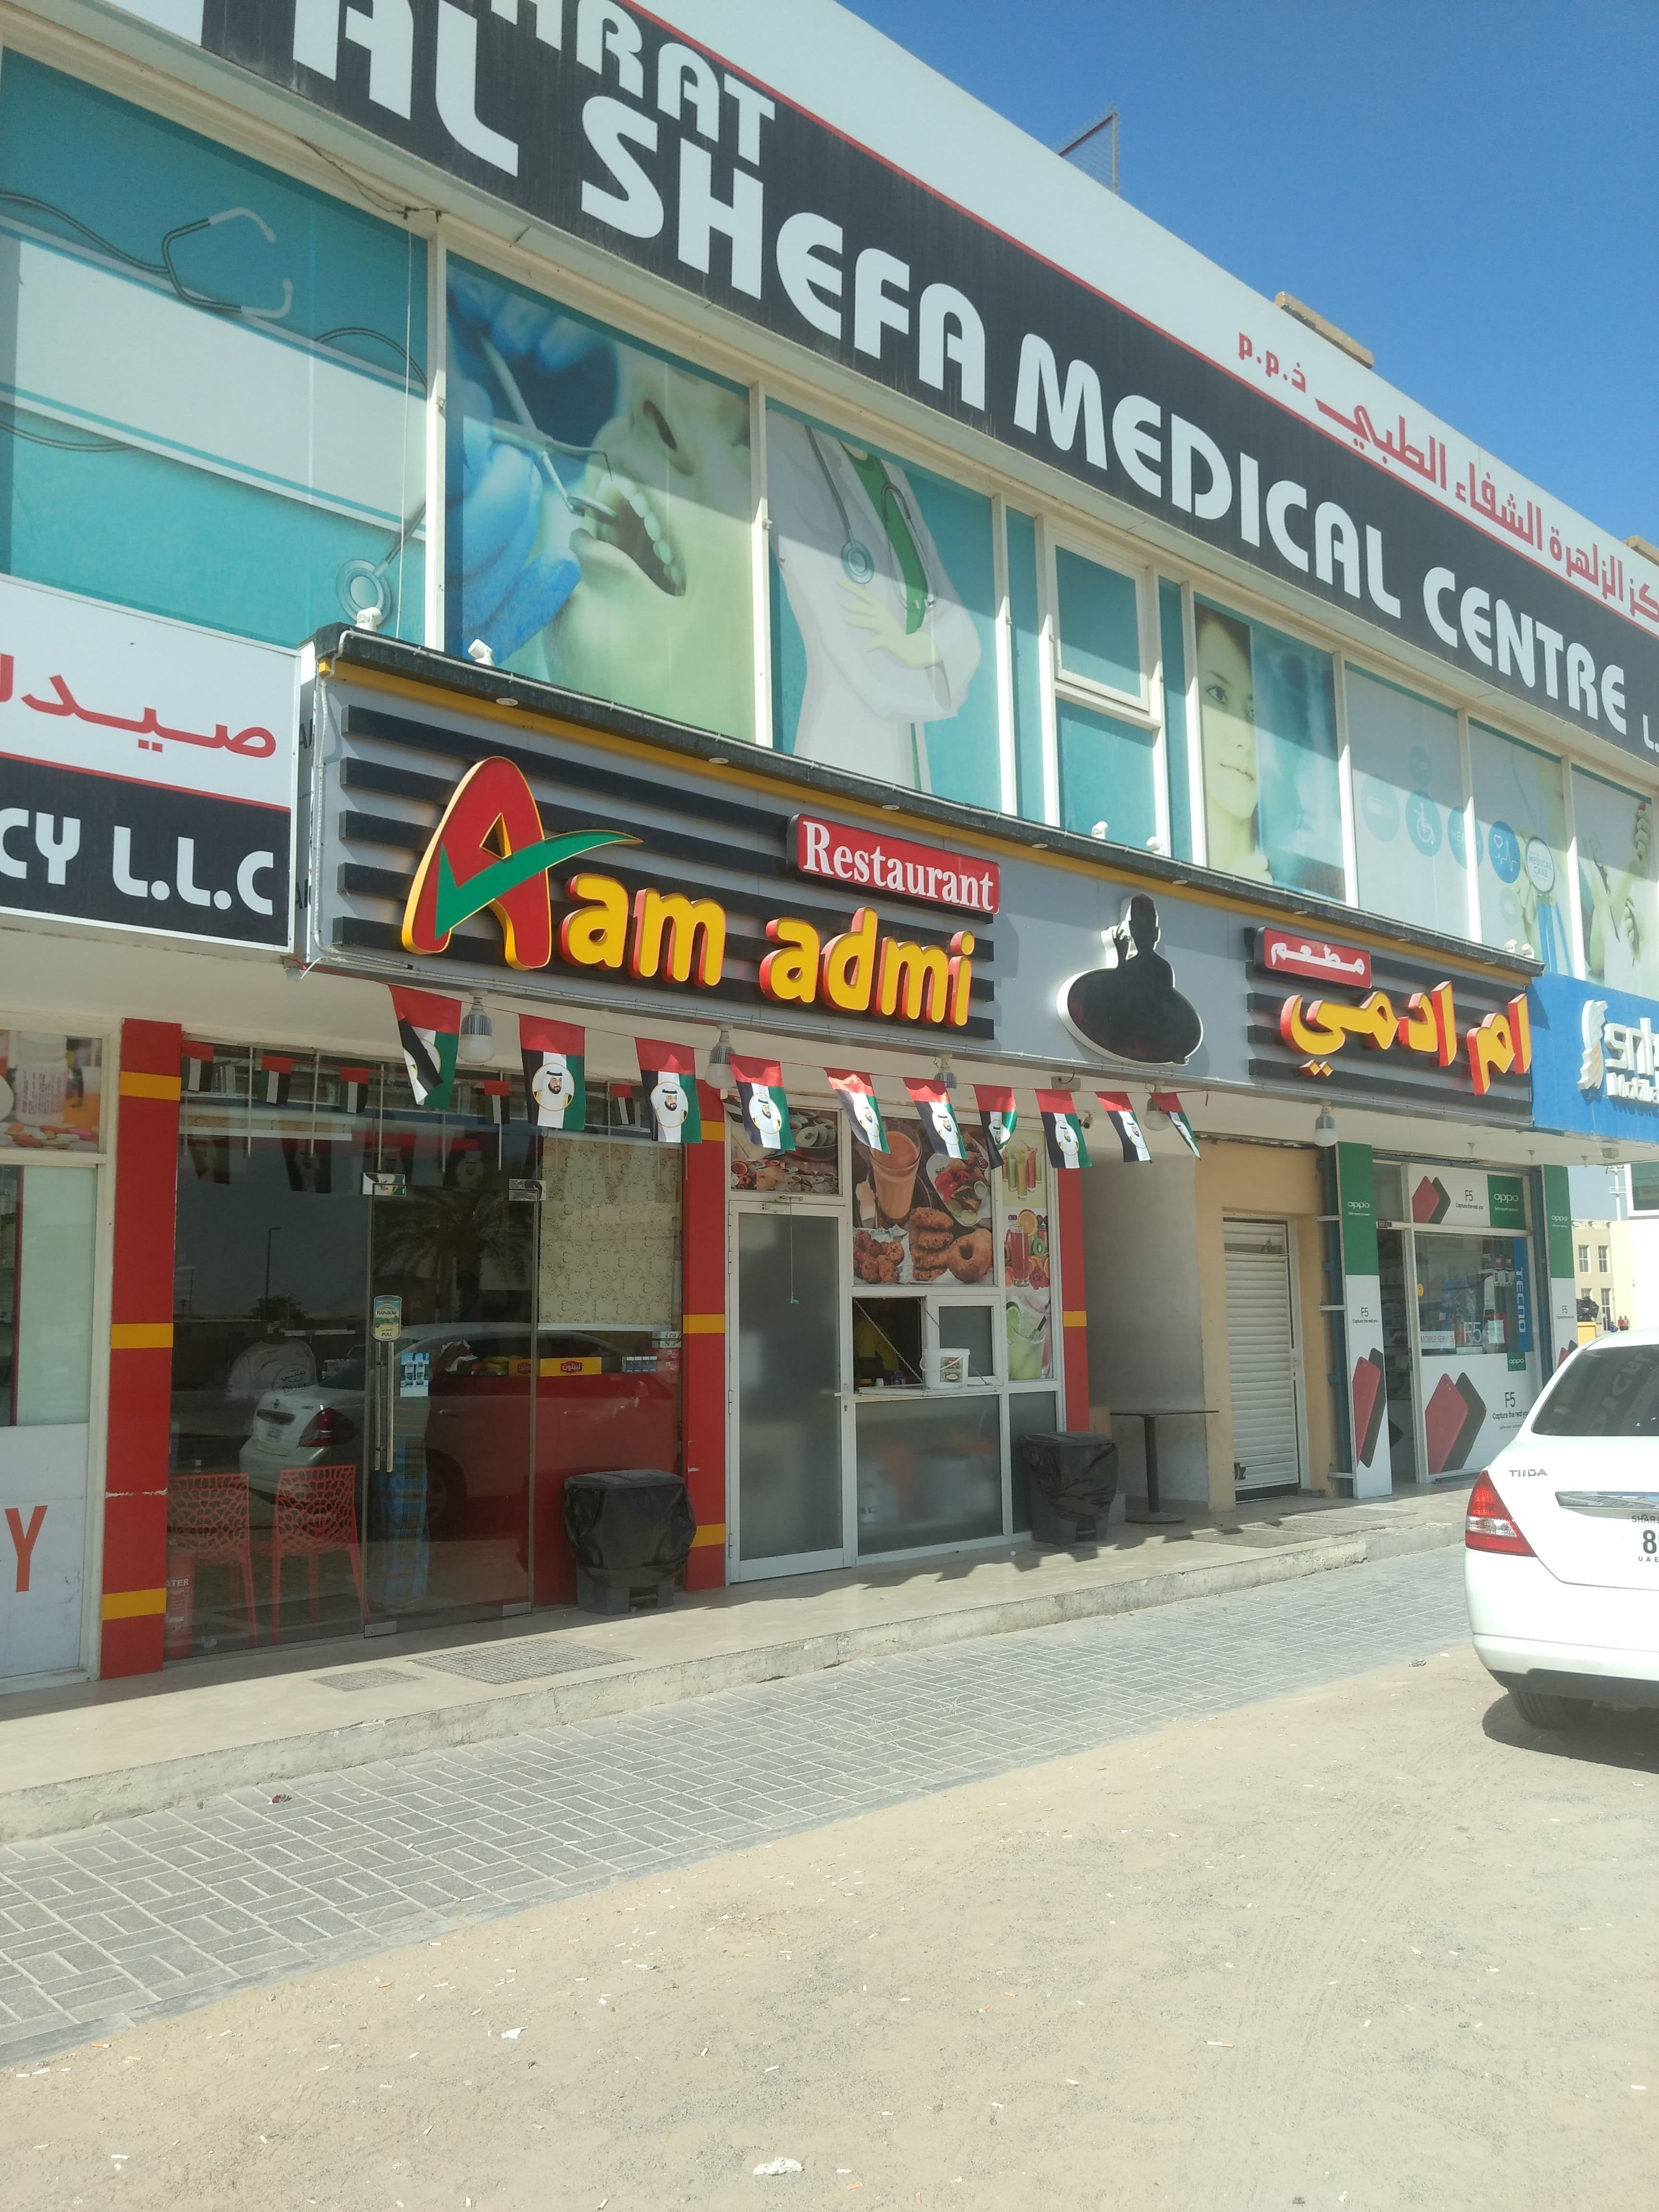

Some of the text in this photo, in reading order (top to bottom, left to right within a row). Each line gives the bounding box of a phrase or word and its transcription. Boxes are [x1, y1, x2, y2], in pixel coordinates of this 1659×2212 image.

[581, 96, 986, 412] SHEFA
[1013, 333, 1401, 620] MEDICAL
[1423, 566, 1627, 735] CENTRE
[1314, 405, 1447, 491] الطبي
[1455, 461, 1543, 552] الشفاء
[112, 825, 274, 915] L.L.C
[802, 820, 994, 914] Restaurant
[758, 906, 975, 1027] admi
[1270, 941, 1366, 976] مطعم
[1347, 1201, 1370, 1209] oppo
[1465, 1190, 1473, 1202] F5
[1494, 1193, 1519, 1203] oppo
[1361, 1307, 1369, 1317] F5
[1515, 1267, 1526, 1333] TECNO
[1505, 1391, 1516, 1408] F5
[1509, 1469, 1548, 1478] TIIDA
[1632, 1515, 1659, 1523] SHAR
[5, 1505, 48, 1593] Y
[166, 1578, 189, 1587] ATER
